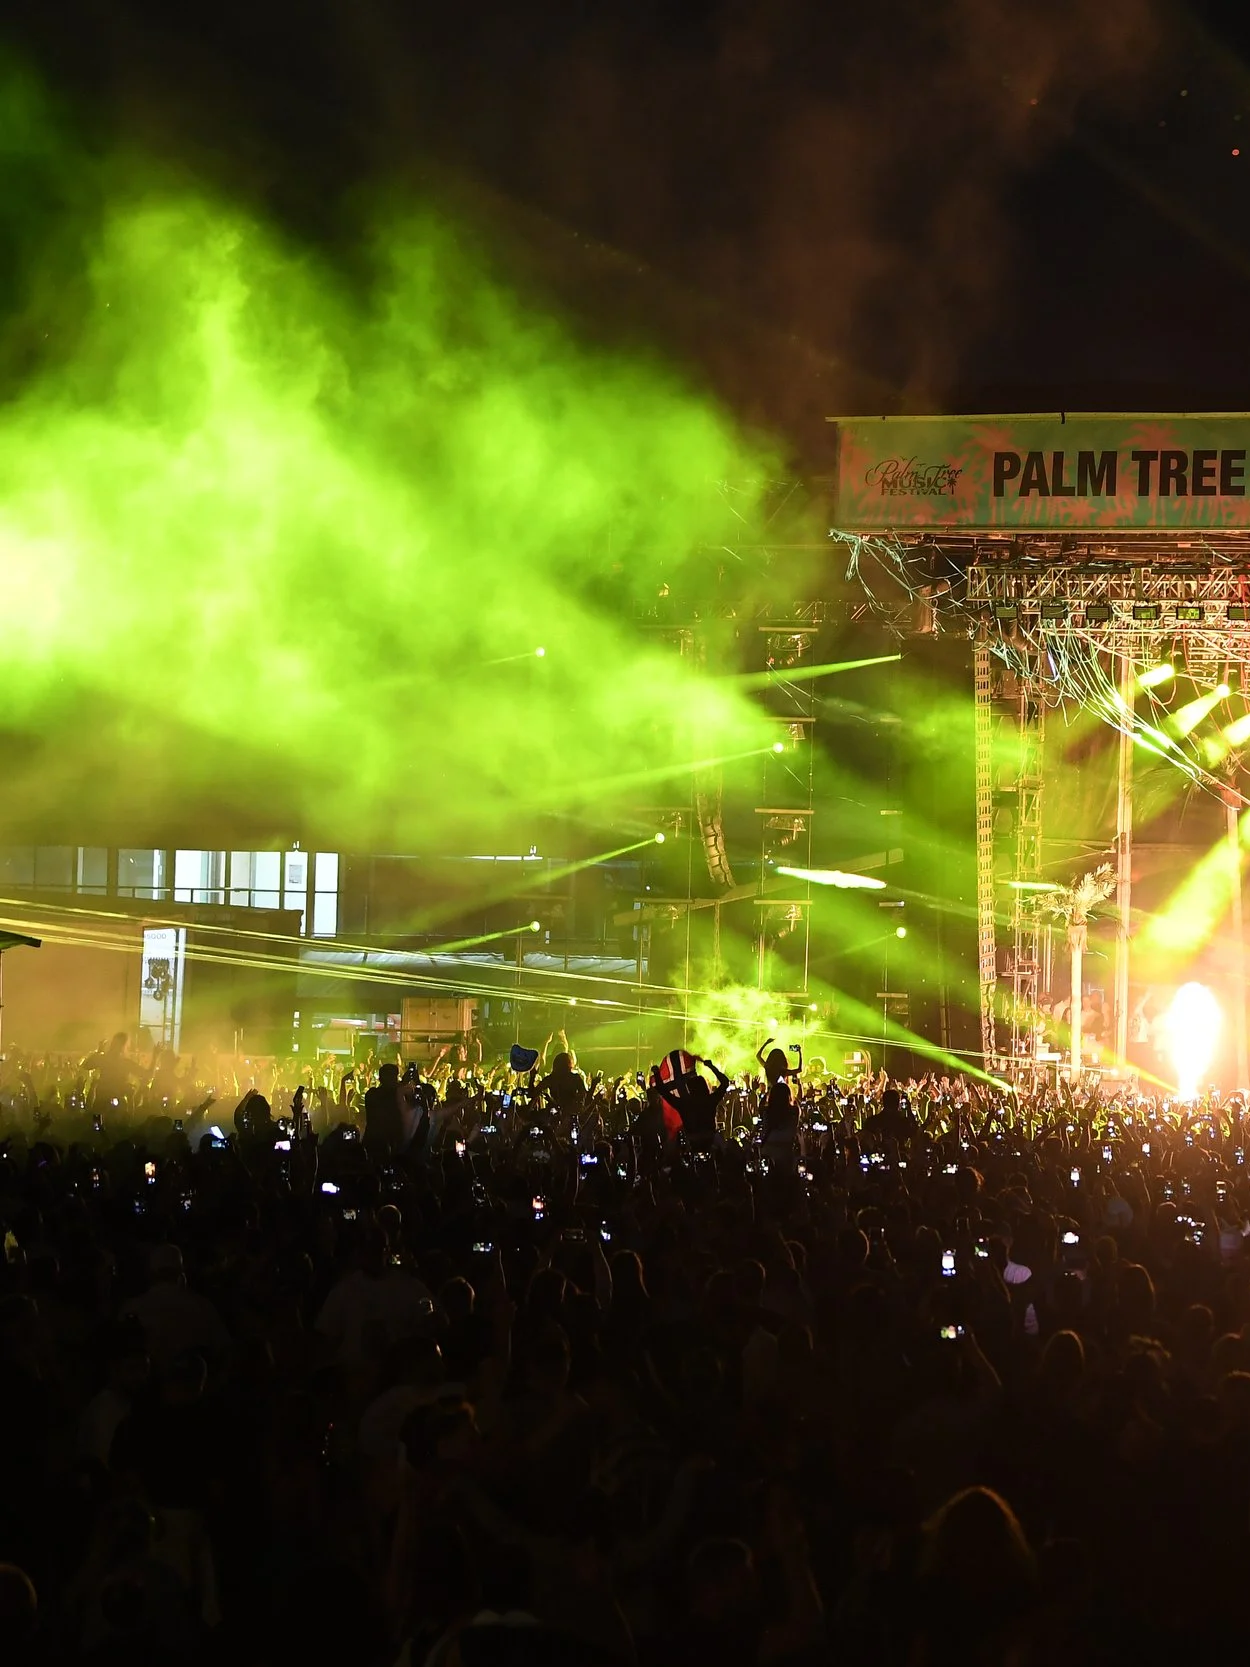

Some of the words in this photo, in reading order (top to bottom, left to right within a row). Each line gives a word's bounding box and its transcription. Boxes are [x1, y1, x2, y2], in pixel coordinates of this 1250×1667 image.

[993, 450, 1117, 497] PALM
[1132, 449, 1246, 496] TREE
[881, 477, 947, 489] MUSIC
[880, 488, 947, 496] FESTIVAL
